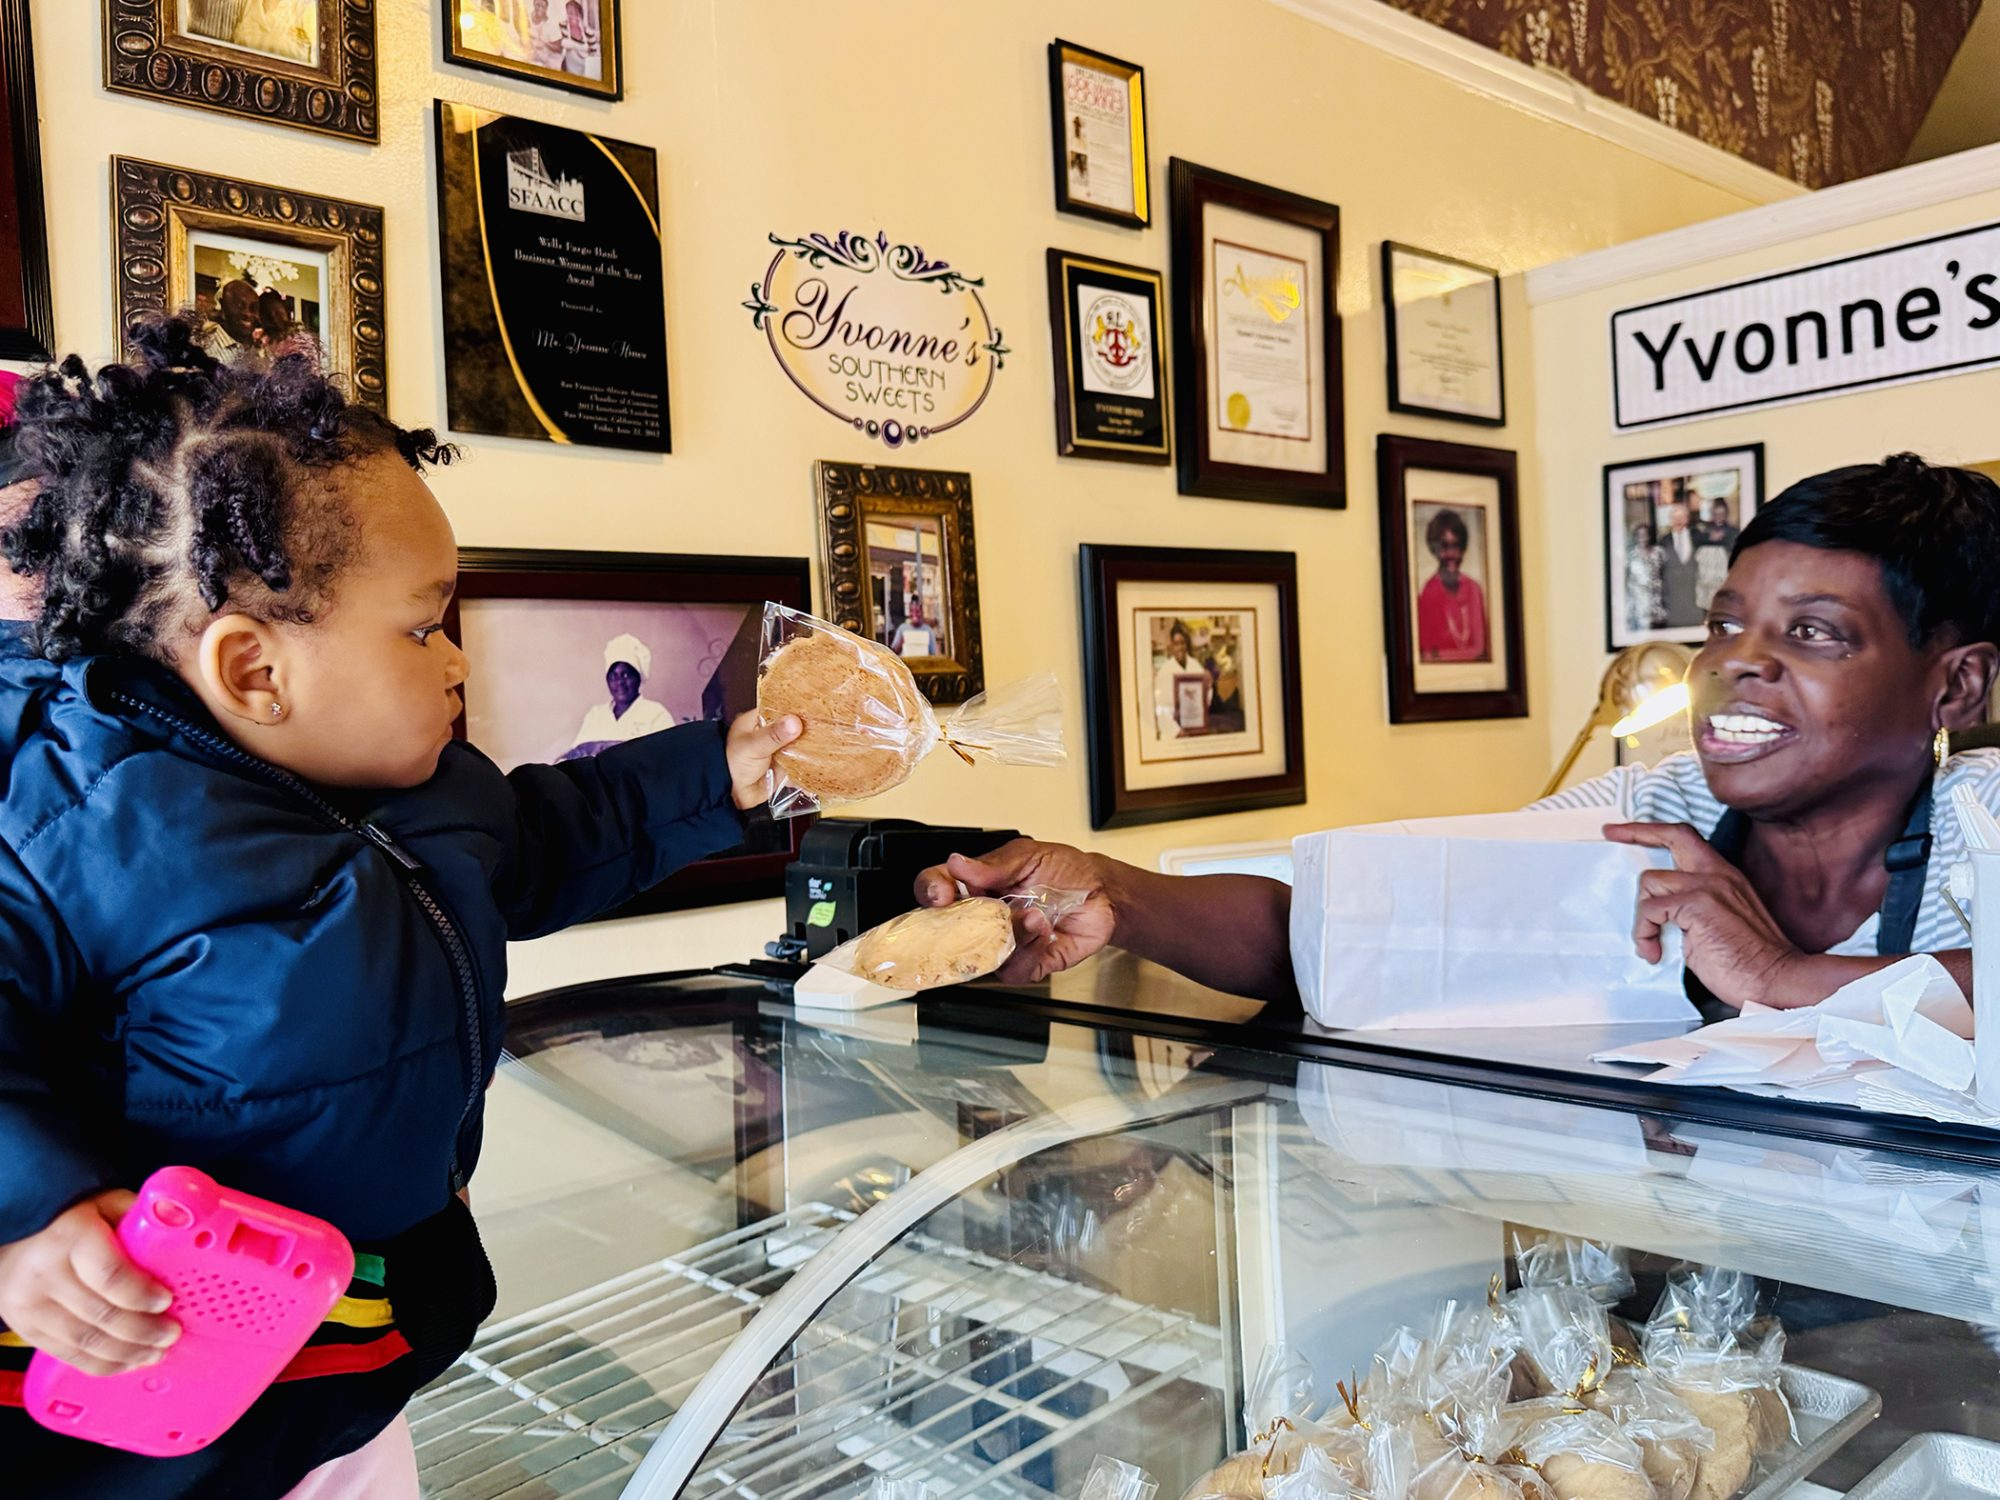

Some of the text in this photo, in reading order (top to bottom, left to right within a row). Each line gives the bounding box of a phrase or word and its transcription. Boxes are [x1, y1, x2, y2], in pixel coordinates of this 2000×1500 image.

[510, 186, 583, 215] SFAACC
[538, 236, 618, 259] Wells Fargo Bank
[514, 249, 642, 281] Business Woman of the Year
[566, 273, 595, 287] Award
[560, 300, 593, 312] Presented
[782, 278, 982, 366] Yvonne's
[1633, 260, 2000, 390] Yvonne's
[565, 332, 609, 355] Yvonne
[828, 353, 946, 390] SOUTHERN
[845, 381, 936, 414] SWEETS
